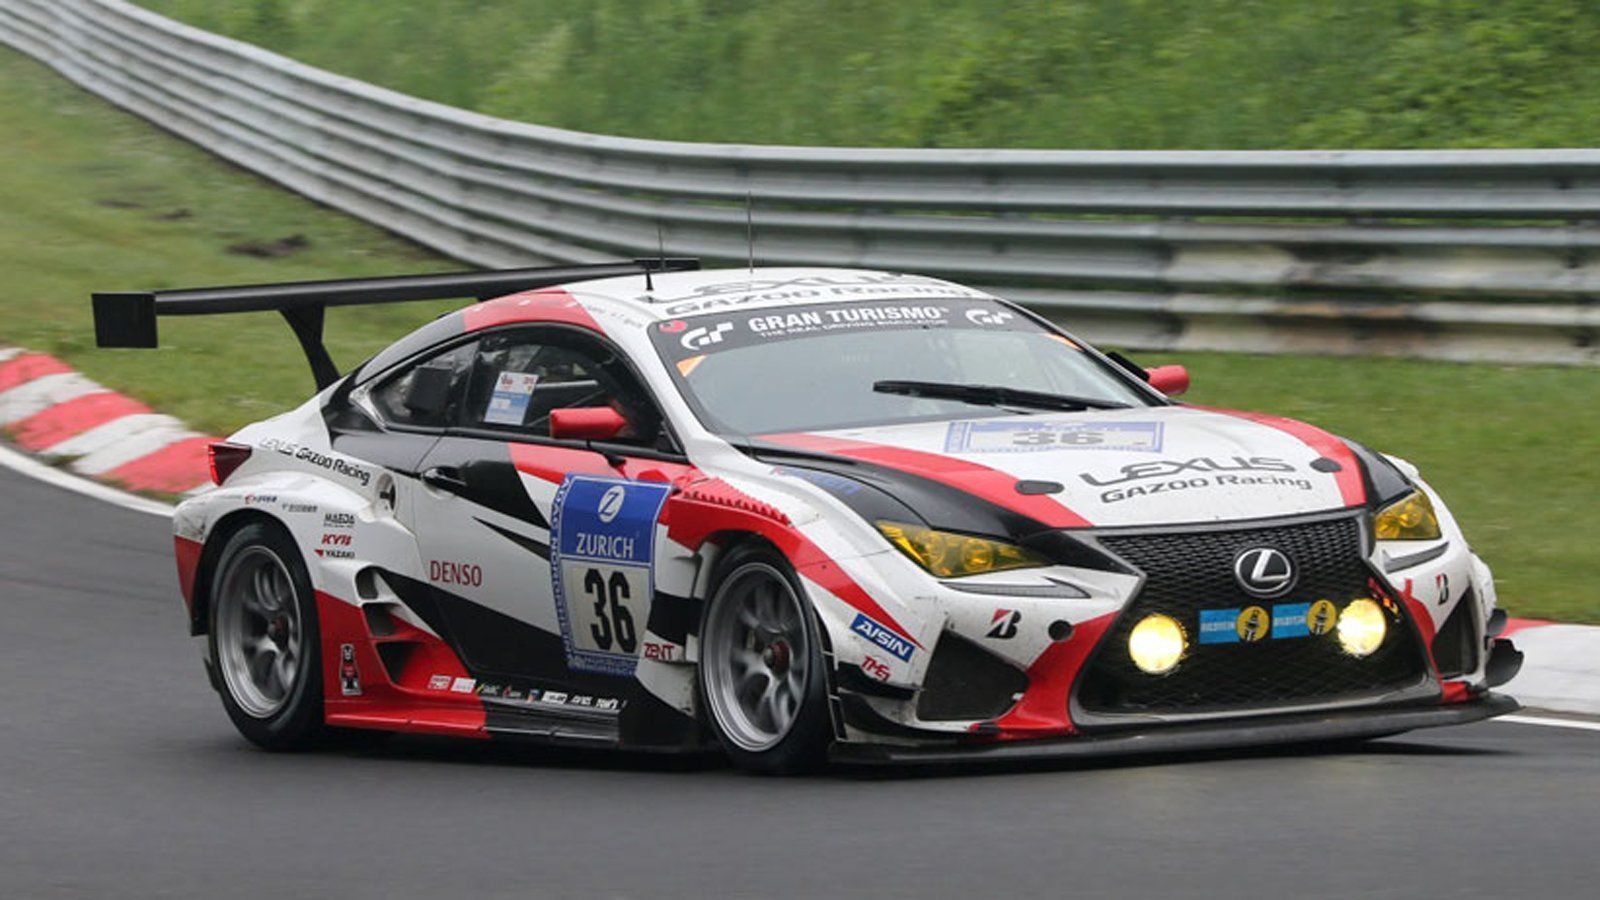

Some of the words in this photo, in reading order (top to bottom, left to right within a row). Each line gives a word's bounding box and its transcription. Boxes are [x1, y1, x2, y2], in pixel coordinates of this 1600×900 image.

[748, 309, 822, 333] GRAN
[826, 306, 942, 323] TURISMO
[1013, 431, 1104, 446] 36
[333, 459, 371, 486] Racing
[1078, 456, 1297, 487] LEXUS
[1100, 475, 1210, 504] GAZOO
[1215, 474, 1313, 491] Racing
[576, 533, 635, 559] ZURICH
[430, 560, 482, 588] DENSO
[584, 567, 637, 654] 36
[644, 642, 675, 660] ZENT
[855, 620, 911, 657] AISIN
